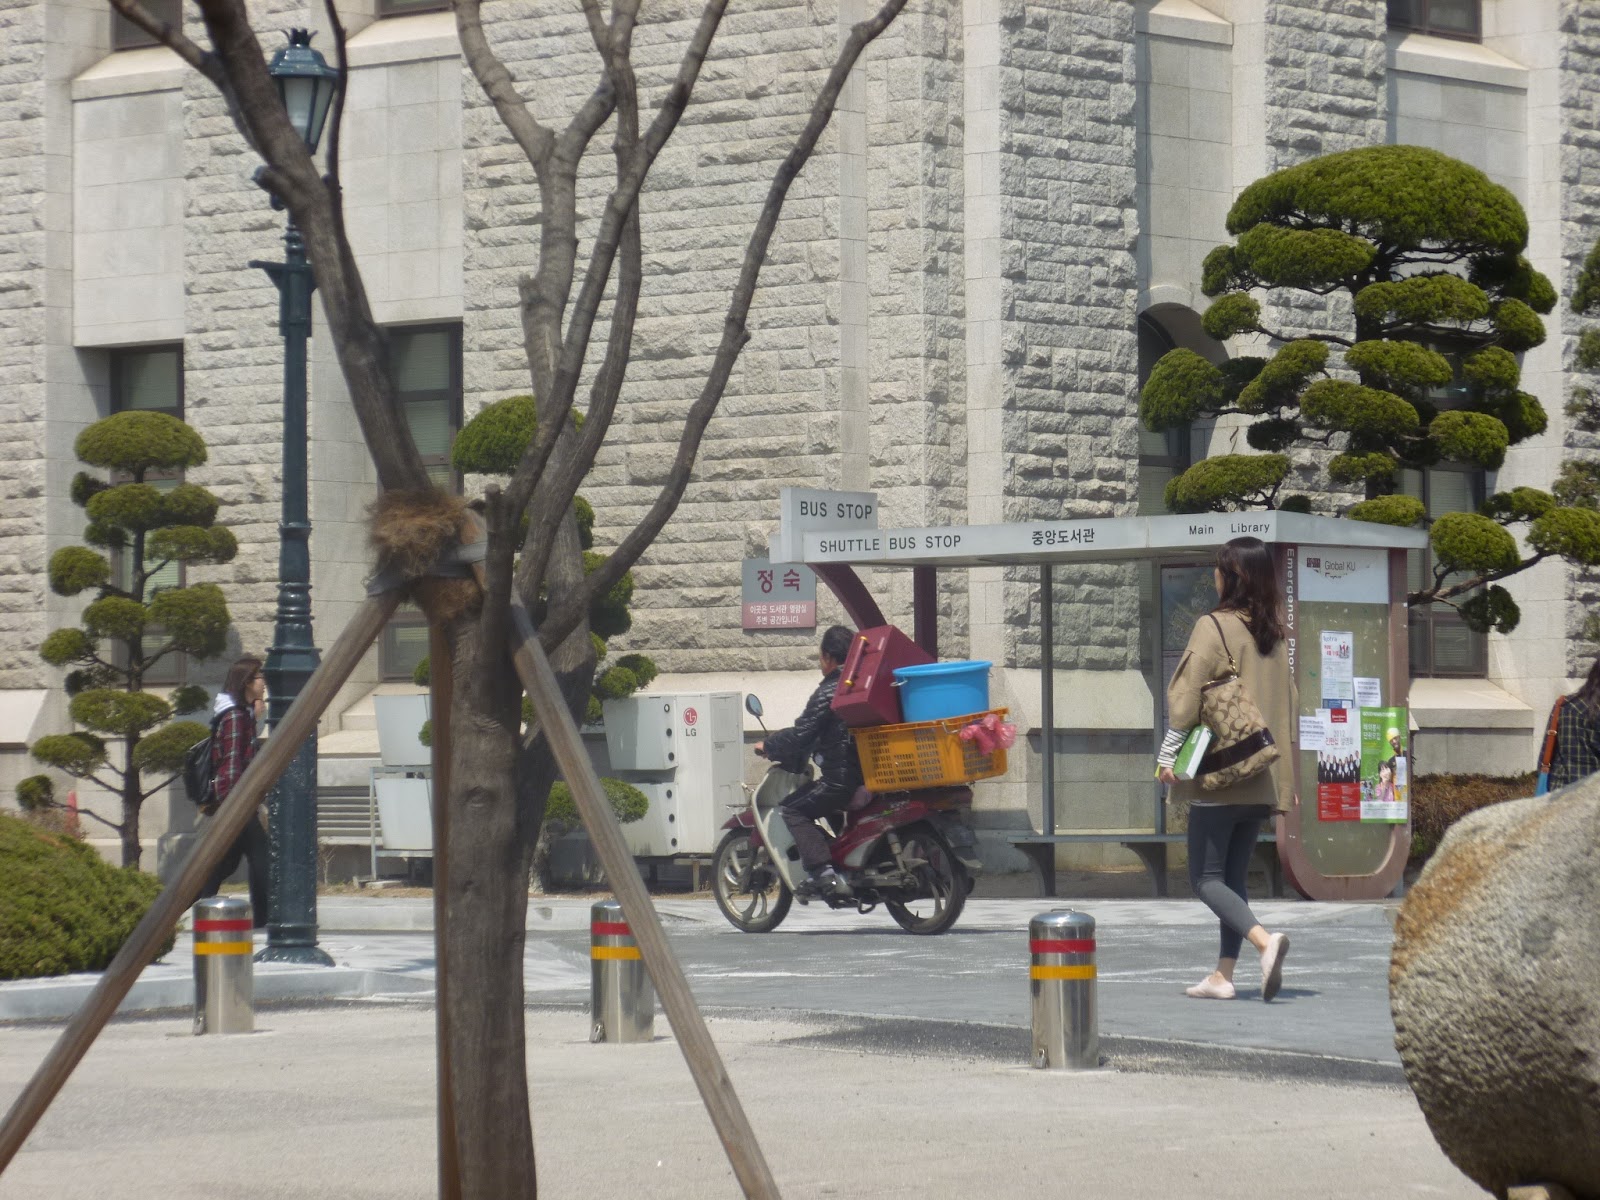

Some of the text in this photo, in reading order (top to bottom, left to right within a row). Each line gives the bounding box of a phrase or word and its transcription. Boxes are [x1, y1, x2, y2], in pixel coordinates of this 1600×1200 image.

[800, 501, 873, 520] BUS STOP
[1189, 523, 1271, 535] Main Library
[1031, 528, 1096, 546] 중앙도서관
[819, 535, 962, 553] SHUTTLE BUS STOP
[1324, 560, 1345, 571] Global
[1346, 561, 1356, 572] KU
[750, 605, 768, 614] 이곳은
[769, 604, 787, 614] 도서관
[1286, 548, 1296, 680] Emergency Phon
[755, 616, 768, 625] 주변
[685, 728, 697, 736] LG
